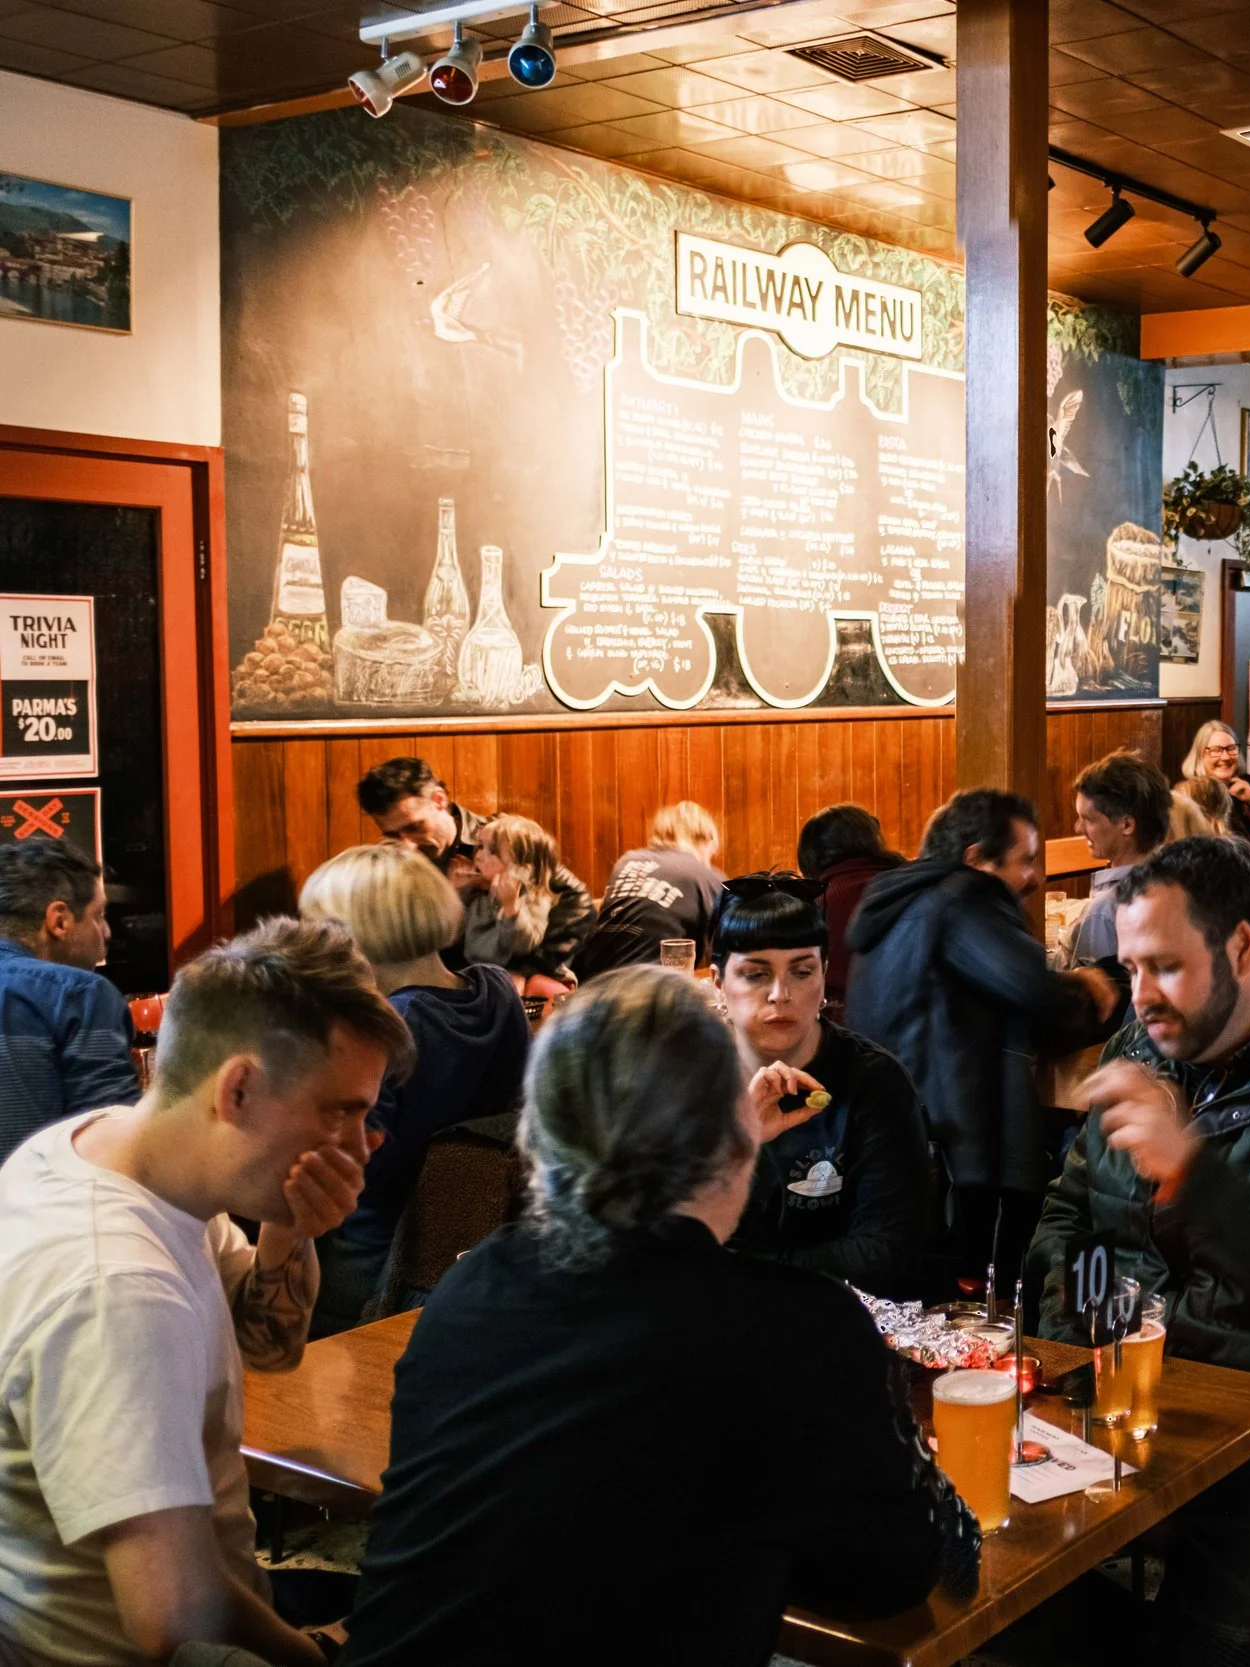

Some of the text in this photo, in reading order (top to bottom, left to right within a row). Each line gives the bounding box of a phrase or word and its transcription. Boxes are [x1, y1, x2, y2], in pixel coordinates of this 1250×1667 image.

[689, 250, 914, 342] RAILWAY MENU
[599, 564, 644, 582] SALADS
[9, 615, 77, 632] TRIVIA
[20, 633, 68, 648] NIGHT
[12, 698, 77, 716] PARMA'S
[18, 717, 73, 742] $20.00
[1072, 1245, 1107, 1313] 10
